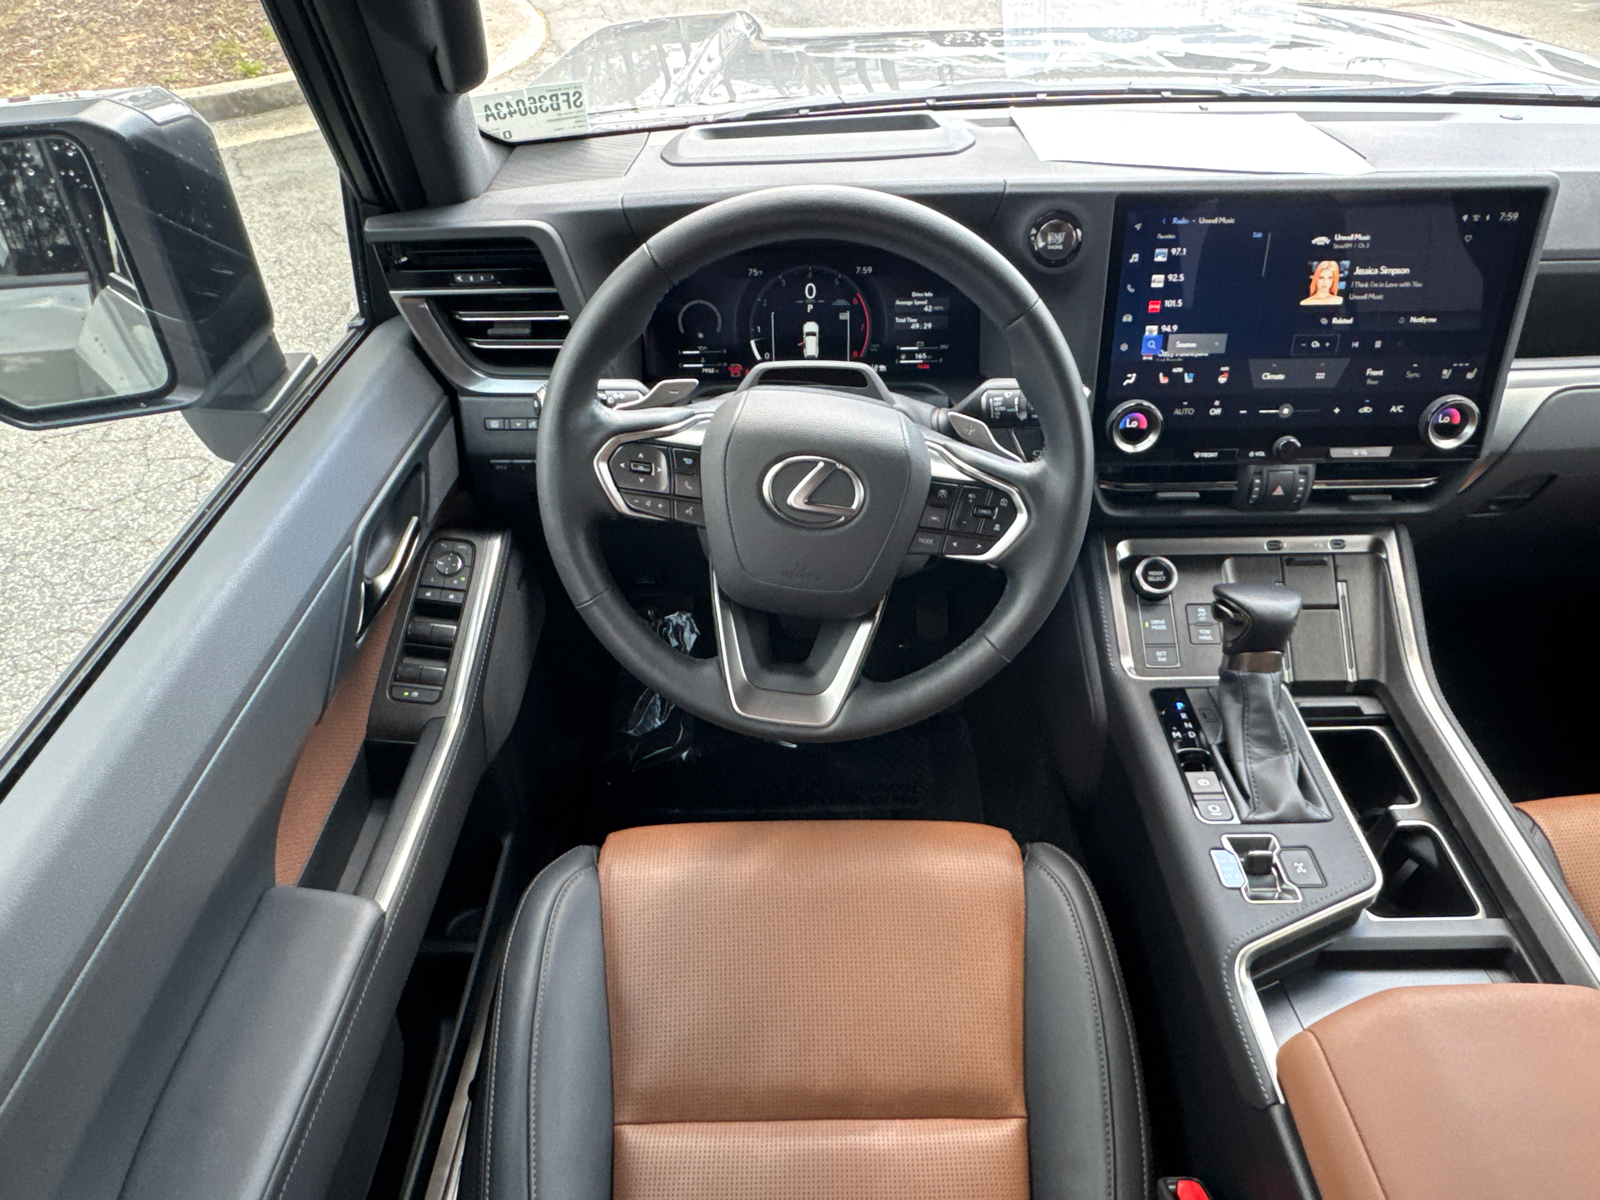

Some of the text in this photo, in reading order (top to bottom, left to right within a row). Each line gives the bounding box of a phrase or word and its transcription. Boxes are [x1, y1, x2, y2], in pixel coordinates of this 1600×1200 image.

[1499, 211, 1519, 221] 7:59
[1172, 217, 1189, 225] Radio
[1218, 217, 1235, 225] Music
[1171, 248, 1186, 256] 97.1
[856, 266, 873, 274] 7:59
[1353, 265, 1410, 276] Jessica Simpson
[1167, 274, 1184, 282] 92.5
[804, 283, 817, 299] 0
[807, 304, 813, 313] P
[1161, 325, 1178, 333] 94.9
[1366, 368, 1384, 376] Front
[1406, 370, 1421, 379] Sync
[1126, 418, 1138, 428] Lo
[1438, 414, 1450, 423] Lo
[1175, 701, 1185, 710] P
